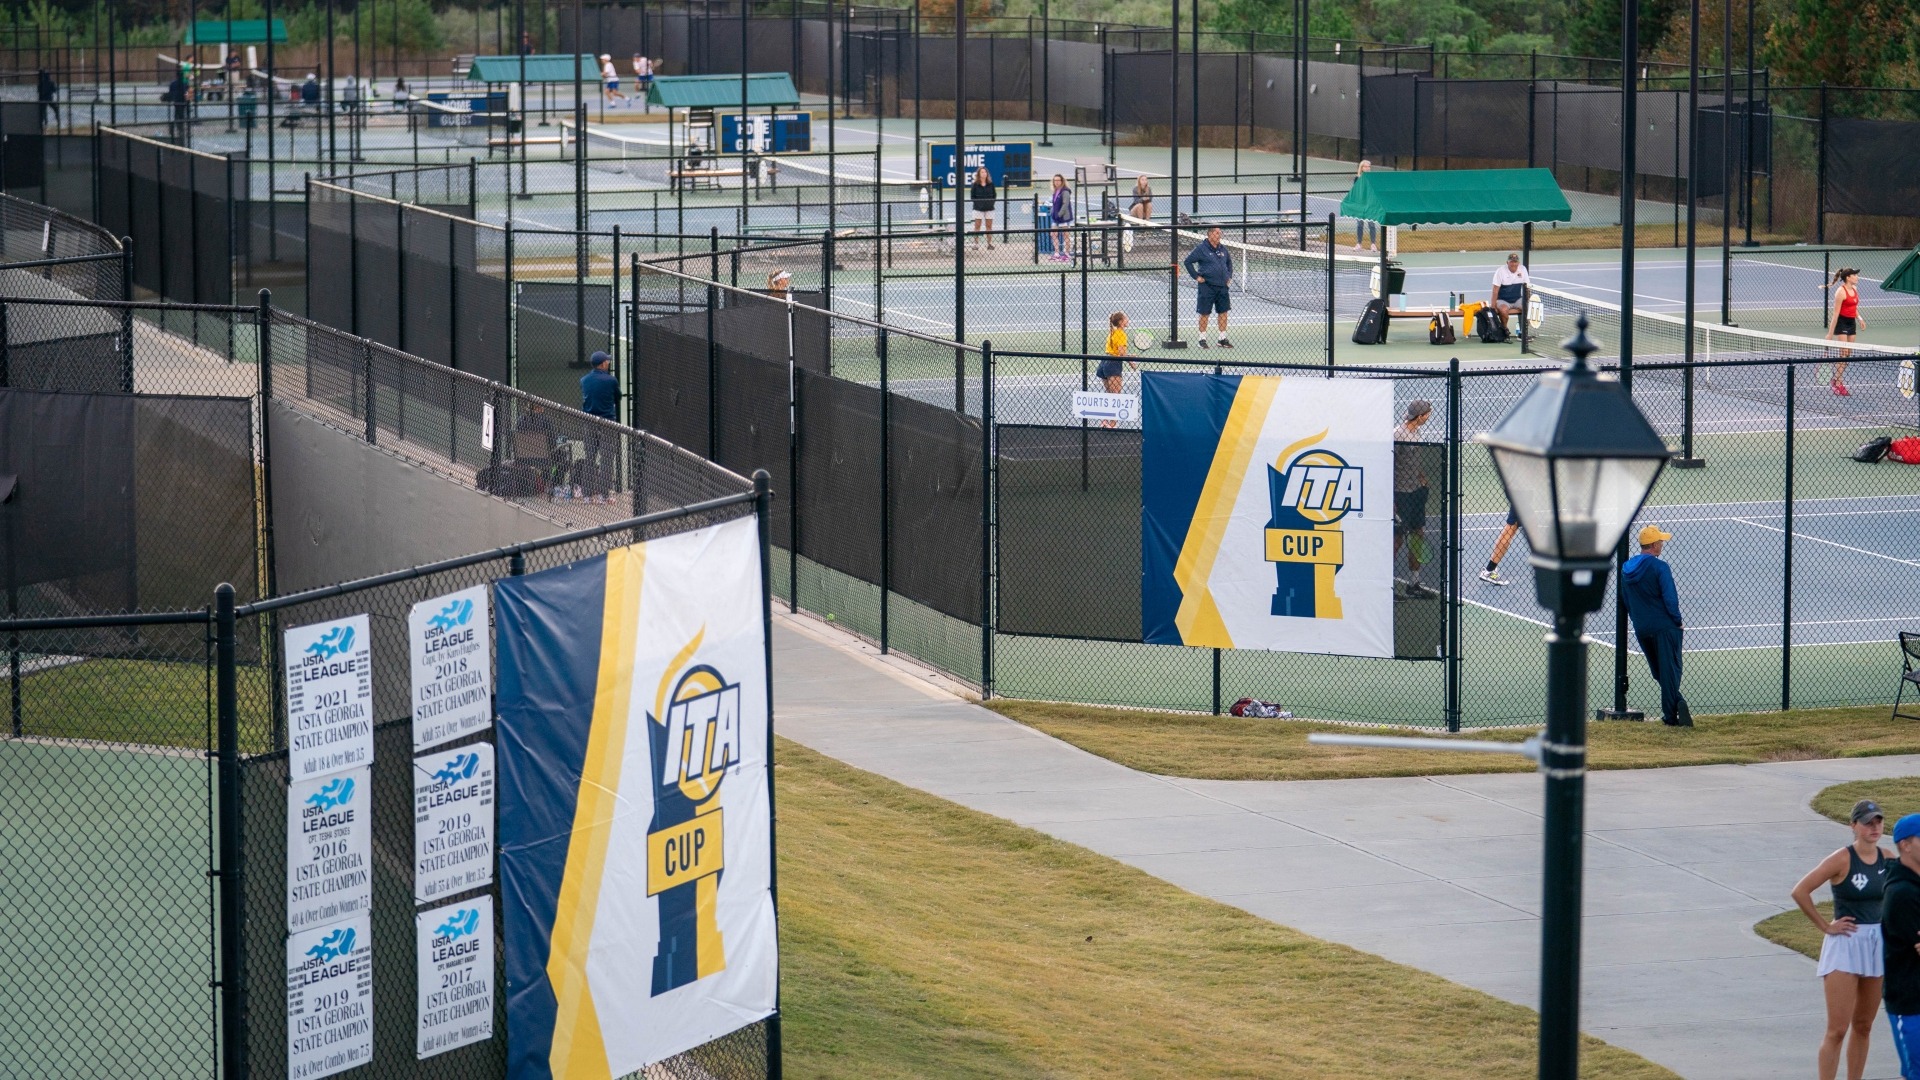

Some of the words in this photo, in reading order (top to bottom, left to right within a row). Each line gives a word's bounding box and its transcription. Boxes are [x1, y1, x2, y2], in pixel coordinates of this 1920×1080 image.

[440, 114, 472, 126] GUEST
[1077, 396, 1109, 407] COURTS
[1112, 399, 1134, 408] 20-27
[1281, 465, 1364, 512] ITA
[1281, 534, 1324, 558] CUP
[424, 627, 444, 640] USTA
[425, 629, 474, 654] LEAGUE
[302, 654, 325, 667] USTA
[303, 659, 356, 682] LEAGUE
[435, 658, 468, 680] 2018
[420, 684, 442, 702] USTA
[444, 669, 482, 691] GEORGIA
[314, 689, 348, 710] 2021
[416, 701, 444, 721] STATE
[445, 685, 487, 712] CHAMPION
[298, 712, 322, 731] USTA
[324, 703, 365, 726] GEORGIA
[446, 721, 458, 735] Over
[460, 715, 477, 730] Women
[294, 730, 323, 752] STATE
[325, 720, 370, 744] CHAMPION
[663, 681, 741, 786] ITA
[332, 753, 344, 767] Over
[345, 750, 355, 763] Men
[356, 747, 364, 762] 3.5
[429, 780, 449, 794] USTA
[429, 785, 479, 808] LEAGUE
[302, 805, 324, 819] USTA
[303, 809, 355, 834] LEAGUE
[438, 813, 471, 834] 2019
[313, 839, 347, 861] 2016
[423, 838, 445, 855] USTA
[448, 825, 486, 847] GEORGIA
[664, 826, 707, 878] CUP
[296, 864, 320, 882] USTA
[322, 852, 363, 876] GEORGIA
[419, 854, 446, 875] STATE
[447, 842, 490, 866] CHAMPION
[292, 881, 321, 903] STATE
[322, 869, 368, 895] CHAMPION
[451, 874, 463, 888] Over
[465, 872, 476, 884] Men
[476, 867, 486, 881] 3.5
[306, 910, 318, 924] Over
[319, 902, 338, 920] Combo
[339, 899, 358, 913] Women
[432, 936, 451, 949] USTA
[432, 938, 480, 963] LEAGUE
[303, 957, 325, 971] USTA
[304, 959, 356, 986] LEAGUE
[442, 967, 473, 988] 2017
[314, 989, 349, 1013] 2019
[427, 994, 448, 1010] USTA
[450, 980, 487, 1003] GEORGIA
[297, 1016, 321, 1035] USTA
[324, 1001, 365, 1026] GEORGIA
[423, 1008, 448, 1030] STATE
[449, 995, 491, 1021] CHAMPION
[293, 1033, 322, 1055] STATE
[324, 1018, 369, 1047] CHAMPION
[448, 1029, 459, 1044] Over
[461, 1024, 478, 1040] Women
[293, 1065, 301, 1080] 18
[308, 1059, 324, 1075] Over
[325, 1051, 346, 1070] Combo
[347, 1049, 360, 1063] Men
[360, 1043, 370, 1058] 7.5
